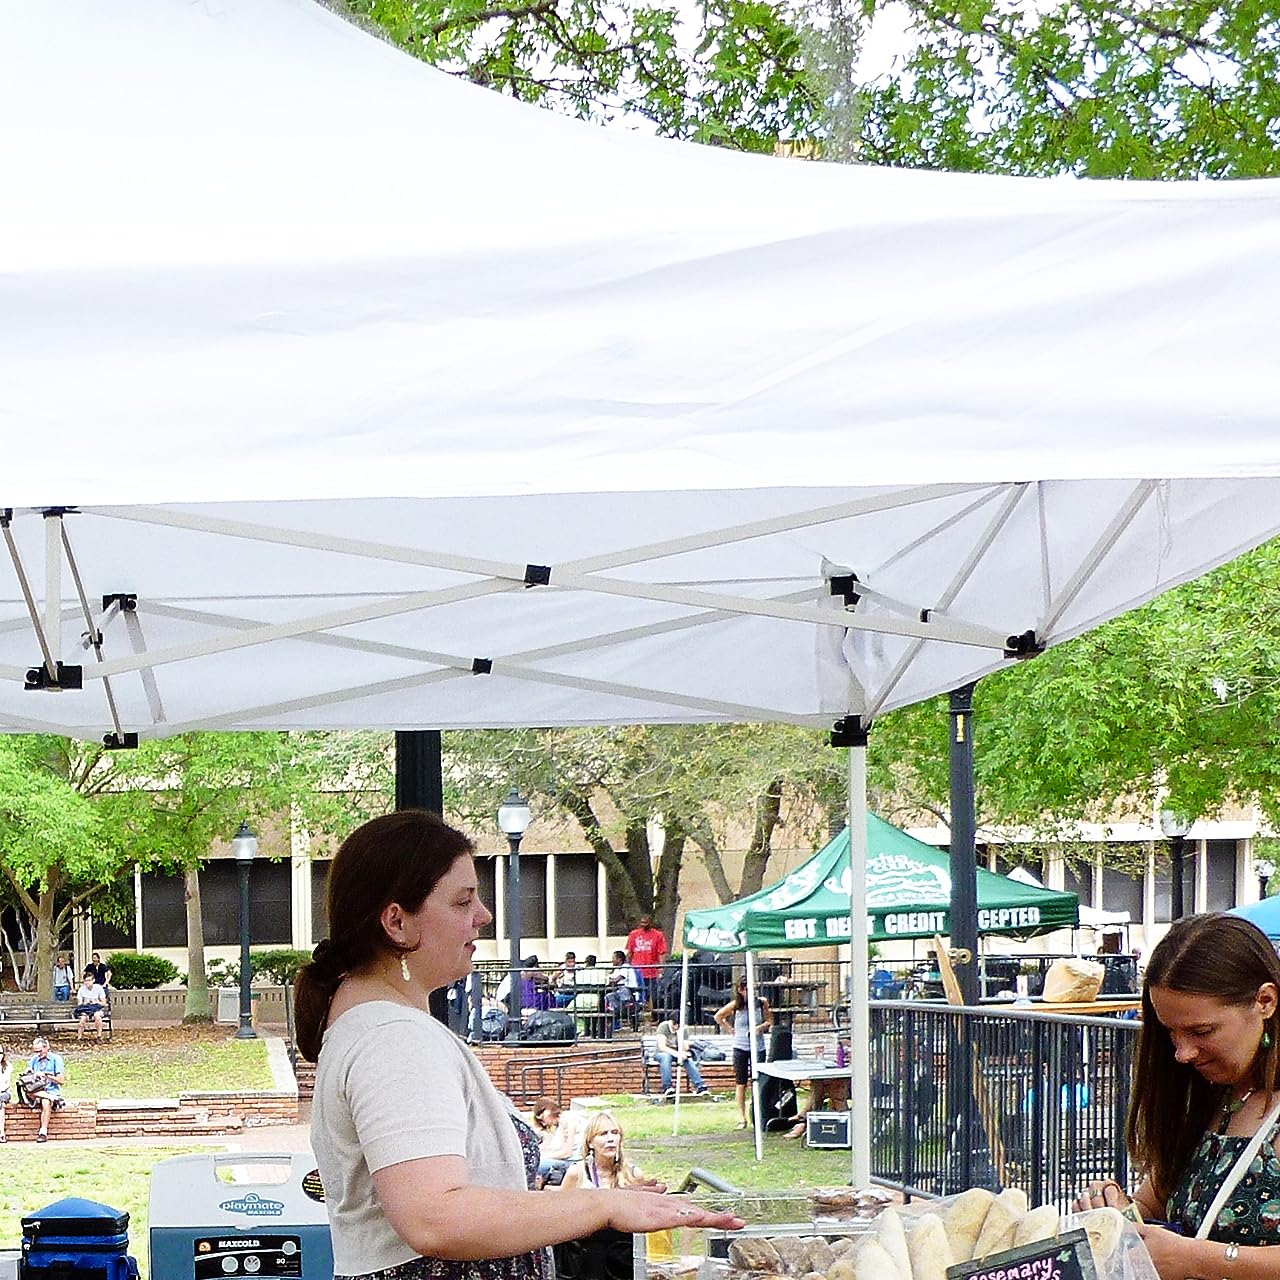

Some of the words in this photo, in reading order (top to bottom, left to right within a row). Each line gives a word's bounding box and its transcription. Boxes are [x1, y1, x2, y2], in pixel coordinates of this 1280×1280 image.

[826, 916, 875, 937] DET
[884, 911, 945, 935] CREDIT
[222, 1200, 283, 1211] playmate
[218, 1240, 260, 1248] MAXCOLD
